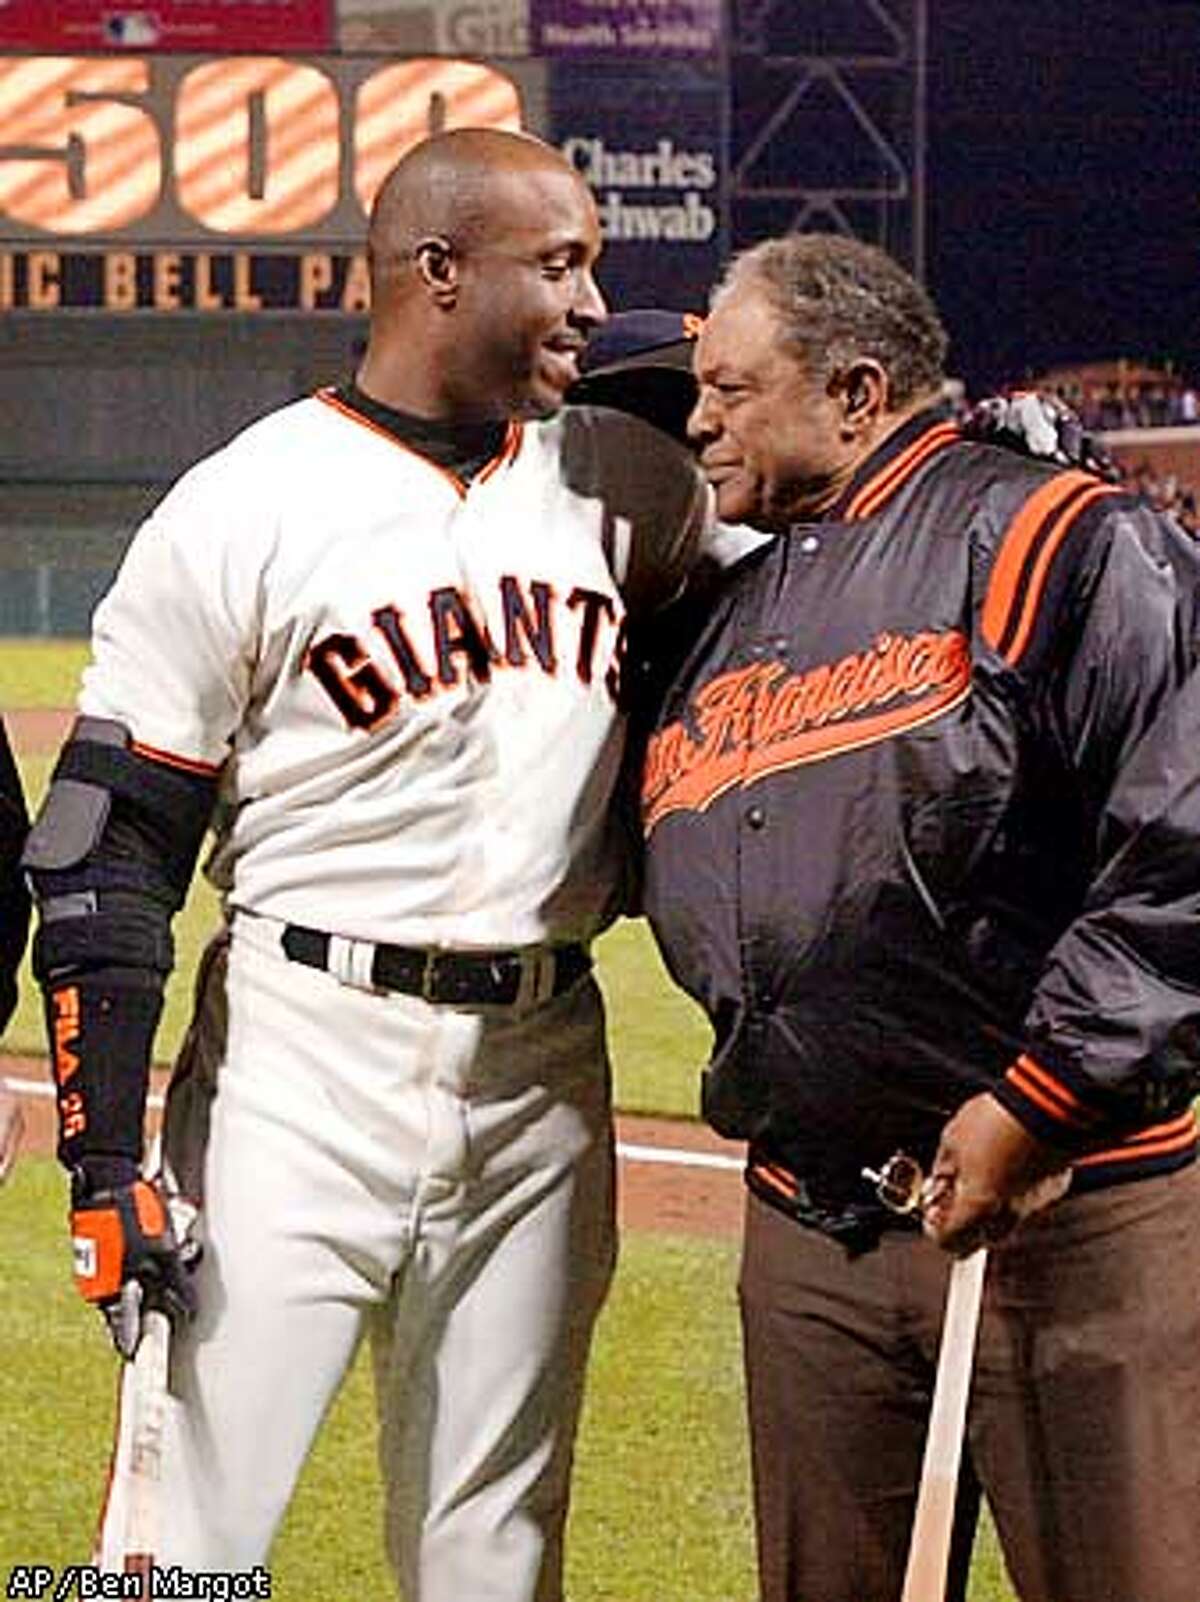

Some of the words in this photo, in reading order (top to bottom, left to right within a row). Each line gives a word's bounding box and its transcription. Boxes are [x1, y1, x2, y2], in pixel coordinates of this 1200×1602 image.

[563, 137, 717, 189] Charles
[597, 192, 716, 240] chwab
[105, 253, 263, 312] BELL
[302, 253, 371, 312] PA
